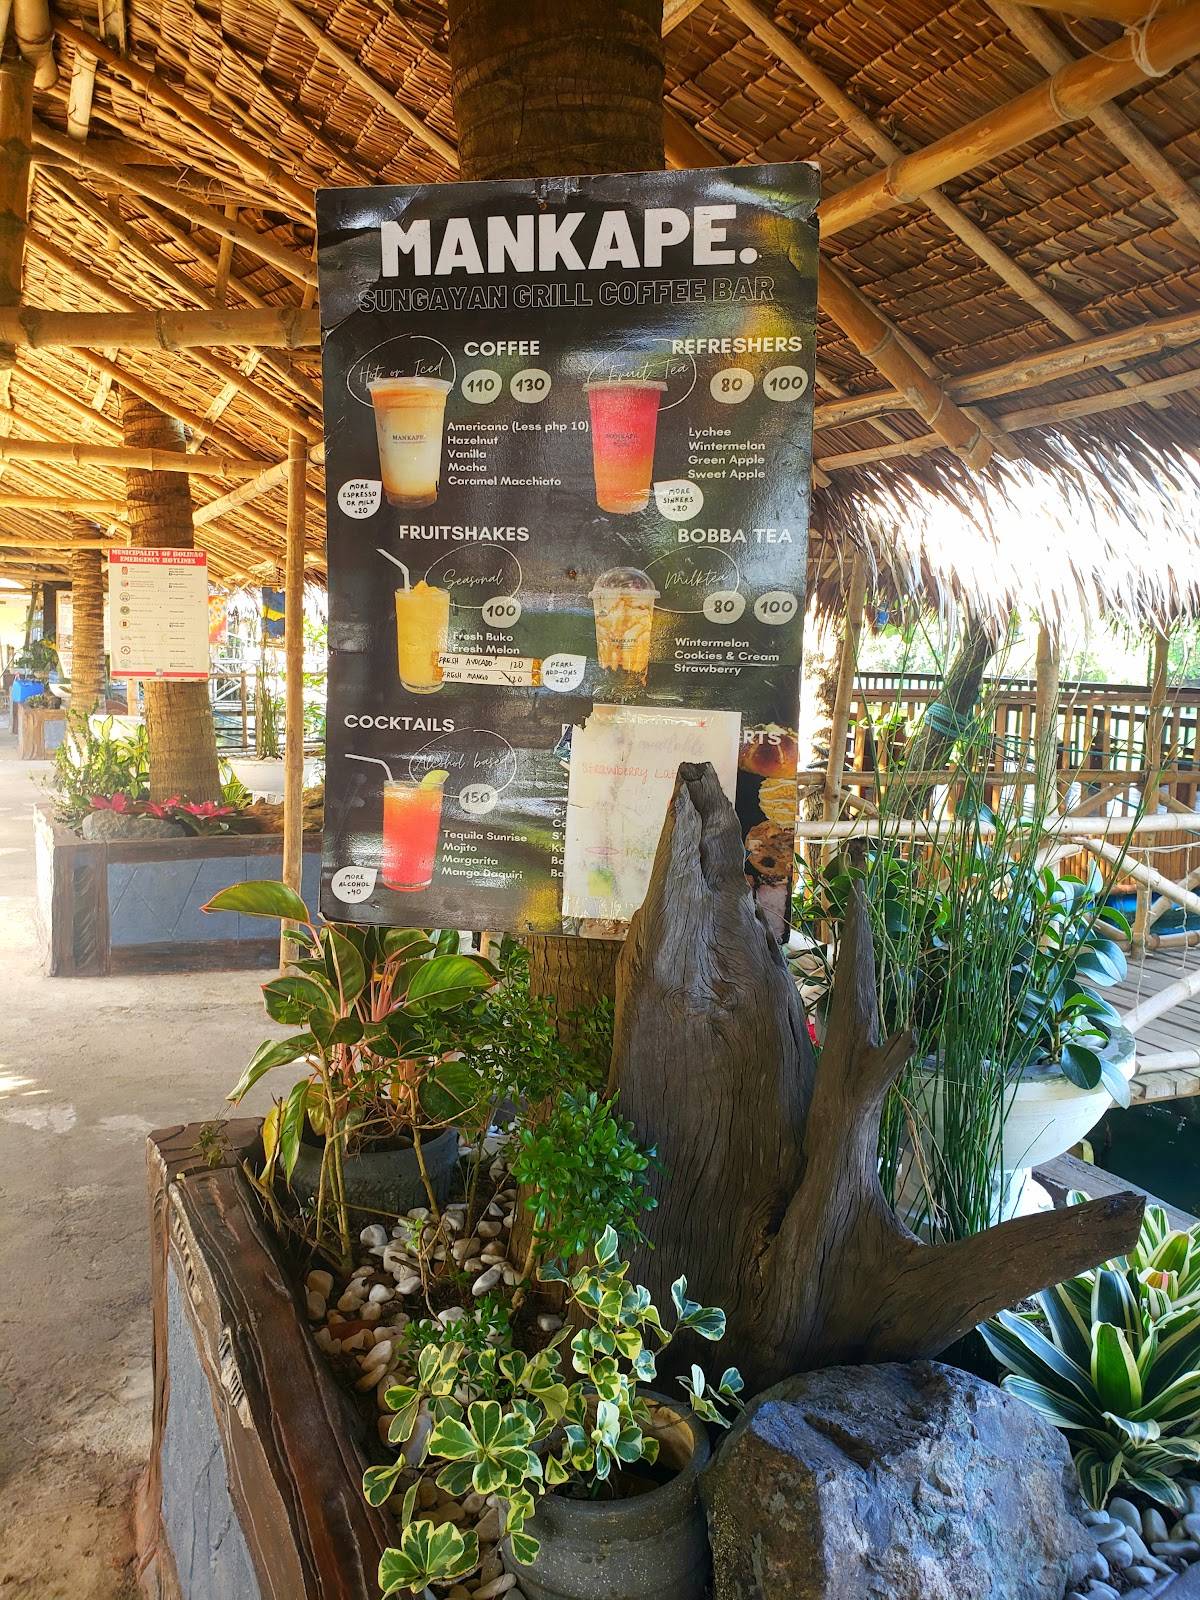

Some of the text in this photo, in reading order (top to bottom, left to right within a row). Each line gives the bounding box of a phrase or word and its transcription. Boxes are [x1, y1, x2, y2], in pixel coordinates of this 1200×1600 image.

[381, 204, 758, 277] MANKAPE.
[358, 276, 775, 312] SUNGAYAN GRILL COFFEE BAR
[463, 340, 540, 357] COFFEE
[672, 336, 803, 355] REFRESHERS
[359, 357, 444, 386] Hot or Iced
[607, 358, 689, 384] Fruit Tea
[467, 378, 545, 393] 110 130
[721, 376, 803, 392] 80 100
[447, 420, 589, 433] Americano (Less php 10)
[688, 427, 731, 439] Lychee
[447, 435, 499, 445] Hazelnut
[688, 441, 766, 451] Wintermelon
[447, 449, 487, 459] Vanilla
[688, 454, 765, 467] Green Apple
[447, 462, 487, 472] Mocha
[688, 469, 766, 480] Sweet Apple
[447, 476, 562, 486] Caramel Macchiato
[342, 491, 377, 499] ESPRESSO
[668, 488, 691, 496] MORE
[358, 499, 374, 507] MILK
[399, 525, 530, 541] FRUITSHAKES
[677, 528, 793, 543] BOBBA TEA
[442, 568, 504, 589] Seasonal
[665, 568, 730, 589] Milktea
[486, 605, 516, 617] 100
[713, 600, 793, 614] 80 100
[453, 632, 514, 642] Fresh Buko
[674, 637, 750, 648] Wintermelon
[452, 645, 520, 654] Fresh Melon
[674, 651, 780, 661] Cookies & Cream
[674, 664, 742, 676] Strawberry
[343, 714, 455, 732] COCKTAILS
[413, 750, 511, 771] Alcohol based
[462, 792, 490, 804] 150
[442, 830, 528, 842] Tequila Sunrise
[442, 842, 478, 853] Mojito
[441, 855, 498, 866] Margarita
[440, 867, 524, 880] Mango Daquiri
